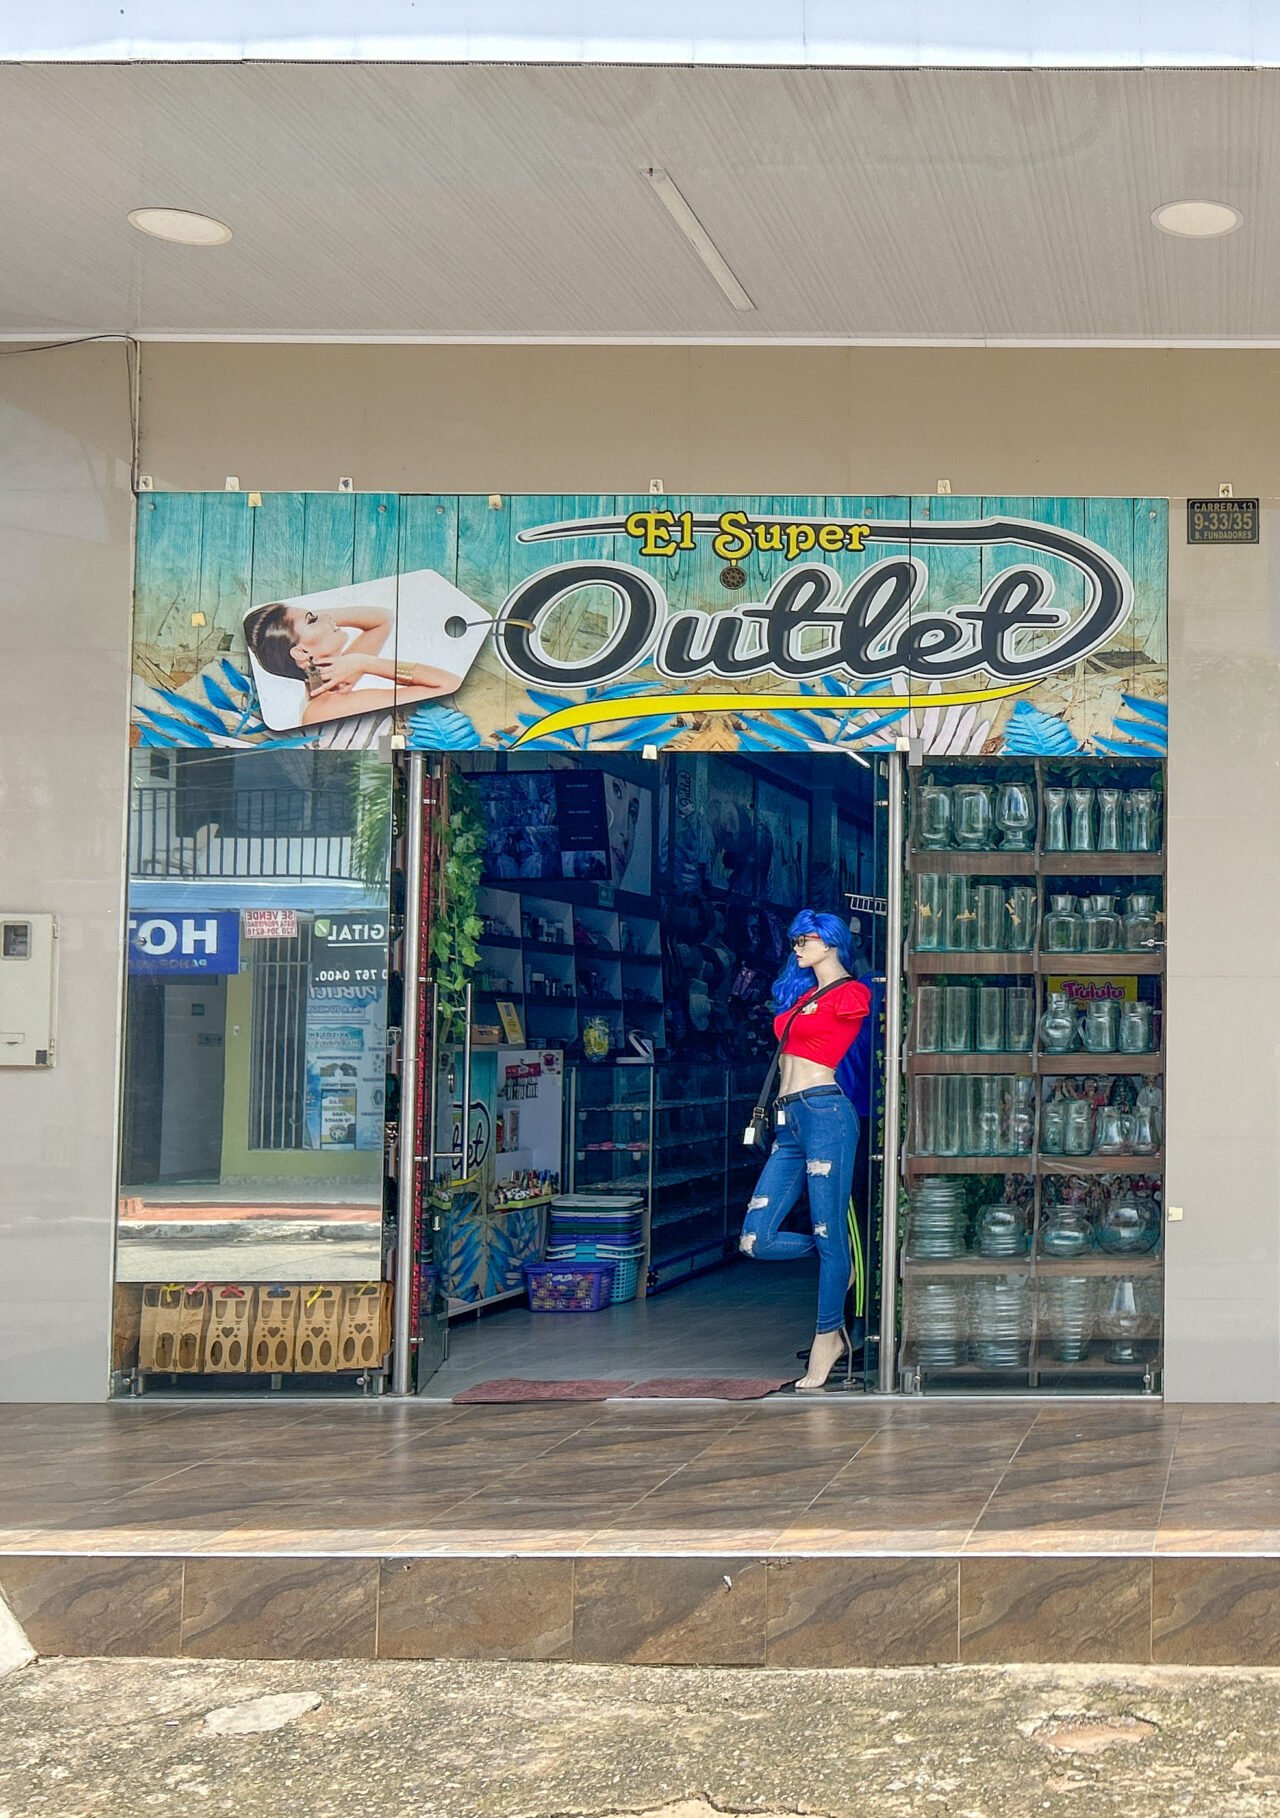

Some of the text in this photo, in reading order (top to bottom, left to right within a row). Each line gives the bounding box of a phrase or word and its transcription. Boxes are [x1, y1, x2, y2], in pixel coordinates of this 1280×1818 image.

[1194, 502, 1253, 512] CARRERA 13
[1194, 512, 1253, 530] 9-33/35
[626, 510, 871, 562] El Super
[1194, 530, 1252, 540] B. FUNDADORES
[495, 550, 1095, 688] Outlet
[1061, 980, 1125, 1000] Trululu
